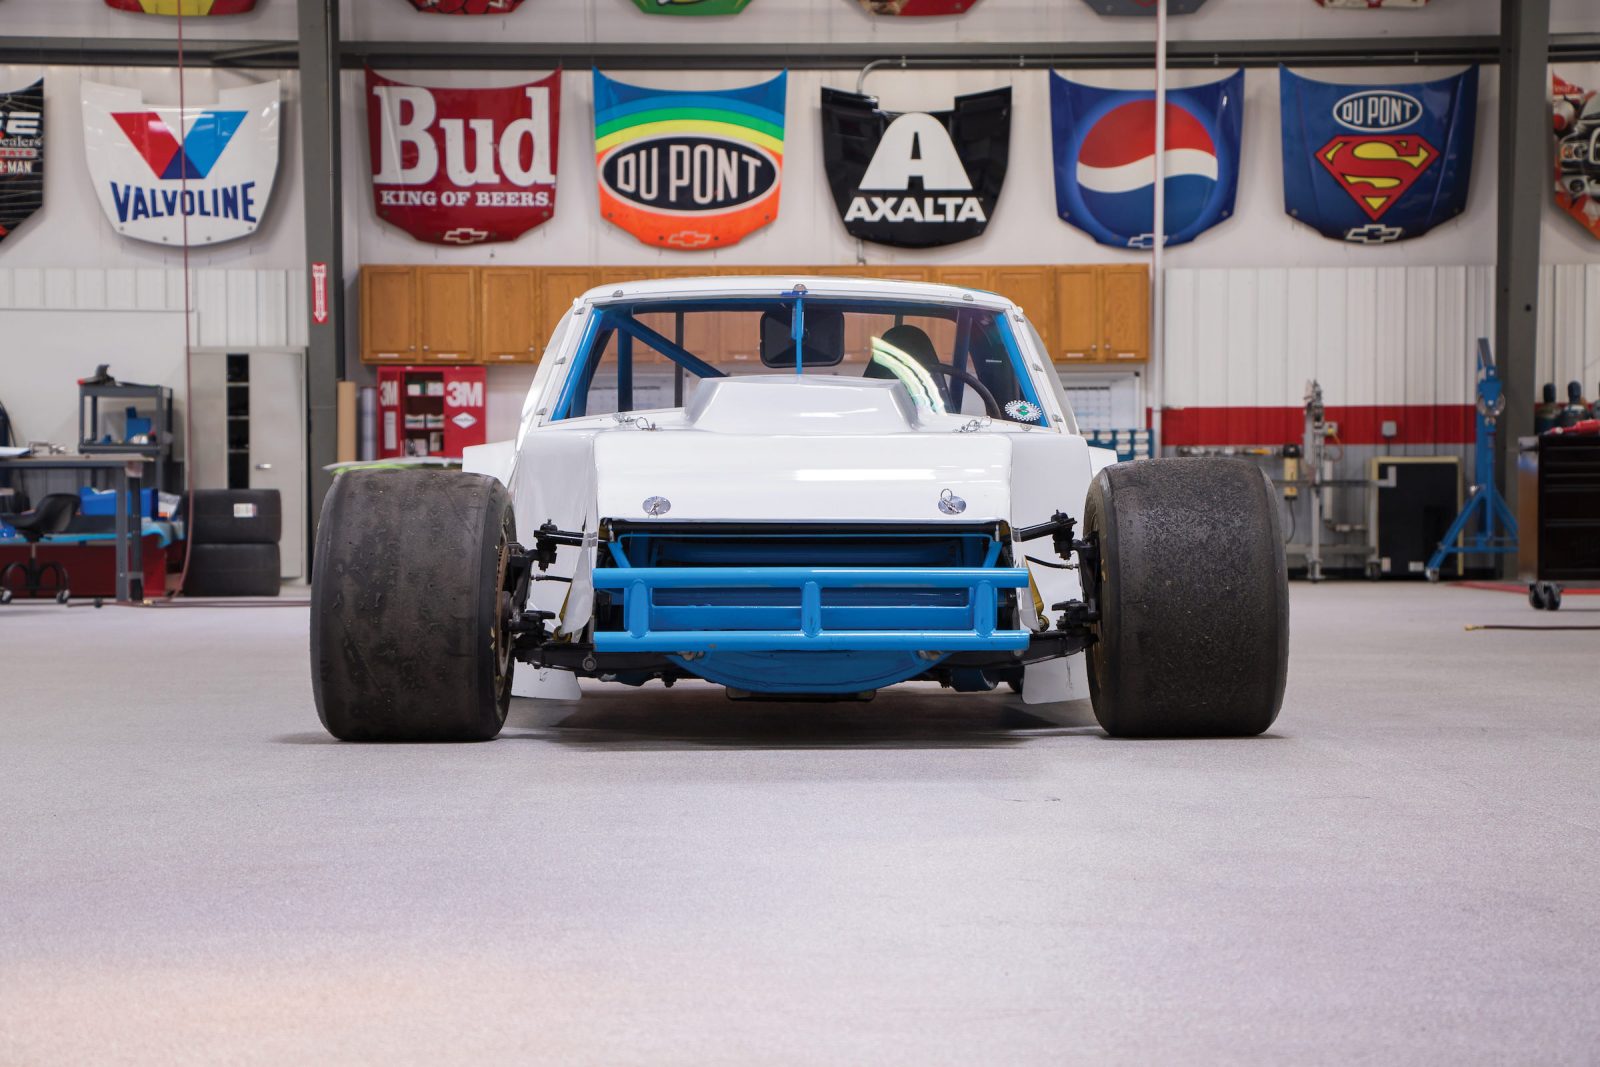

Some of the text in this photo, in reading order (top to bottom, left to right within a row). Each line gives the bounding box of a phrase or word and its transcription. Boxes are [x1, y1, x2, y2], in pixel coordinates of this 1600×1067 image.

[0, 111, 41, 134] E
[1343, 96, 1413, 126] DU PONT
[0, 135, 42, 147] ealers
[373, 86, 556, 187] Bud
[617, 144, 761, 204] DU PONT
[110, 181, 256, 223] VALVOLINE
[380, 190, 437, 206] KING
[440, 190, 470, 206] OF
[844, 197, 987, 222] AXALTA
[380, 381, 398, 406] 3M
[446, 381, 483, 407] 3M
